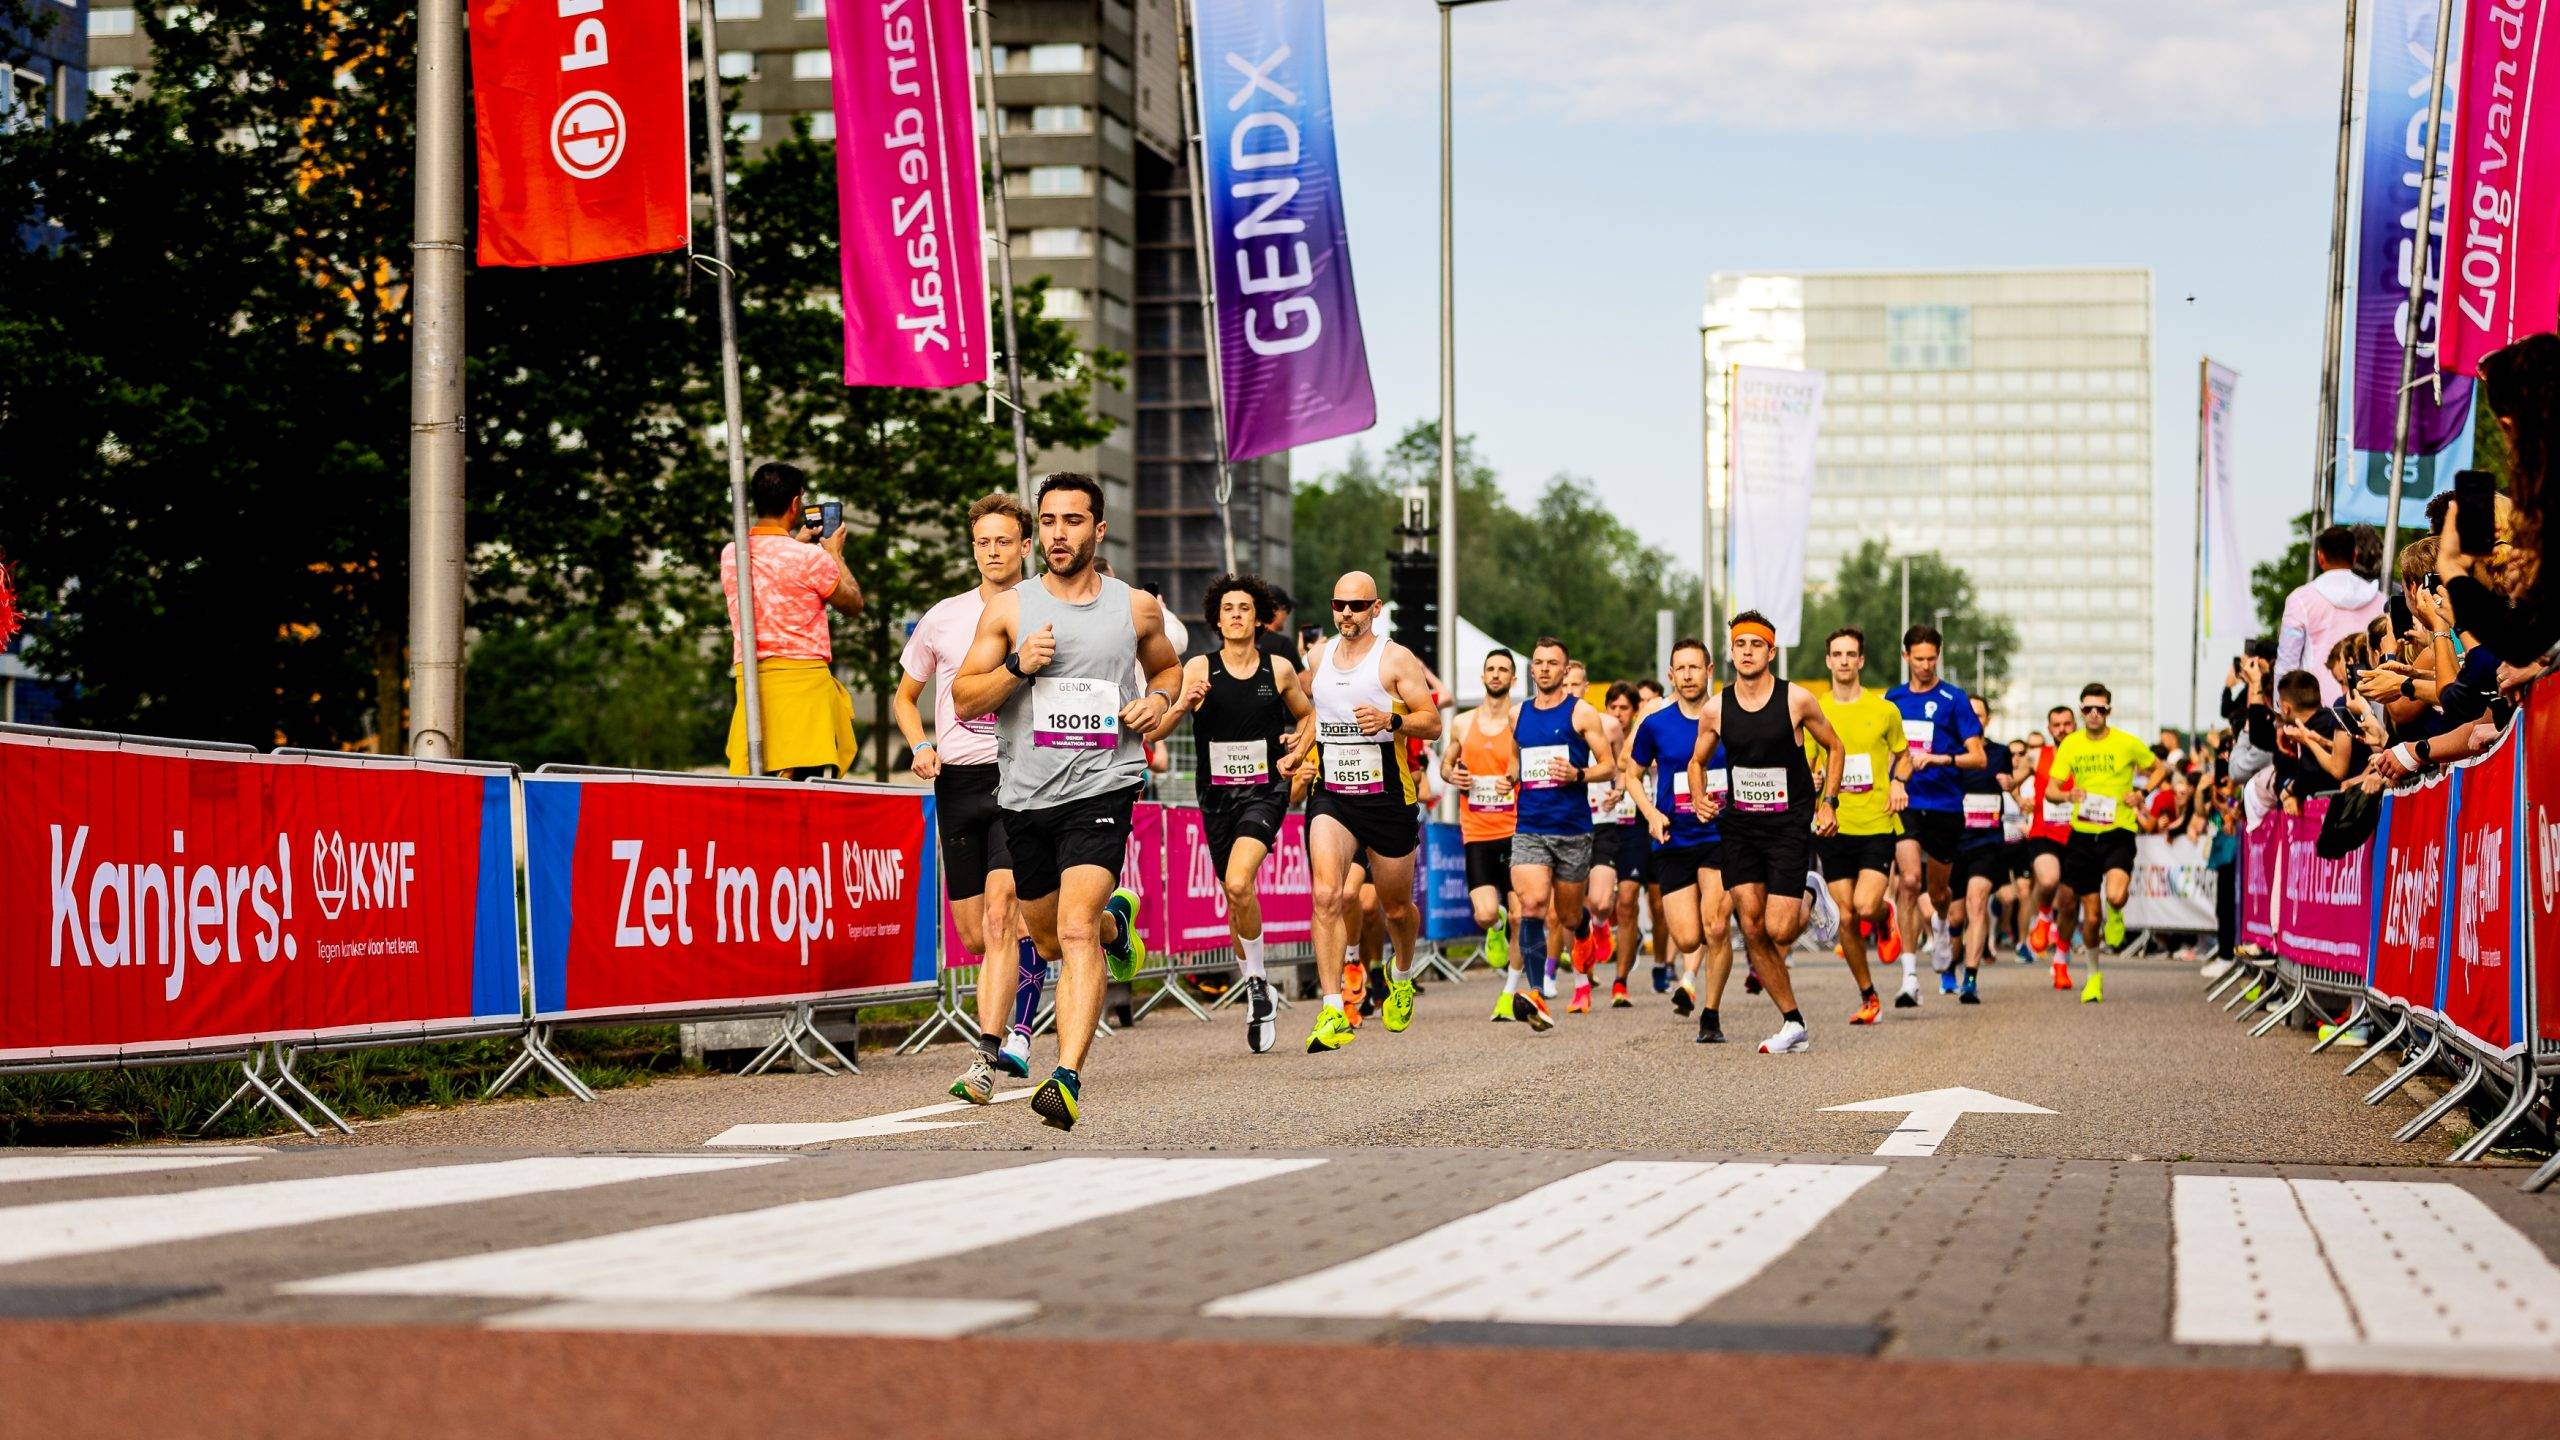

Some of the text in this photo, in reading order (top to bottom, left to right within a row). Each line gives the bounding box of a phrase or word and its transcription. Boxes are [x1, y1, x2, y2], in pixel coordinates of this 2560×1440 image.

[2479, 60, 2517, 175] van
[1225, 45, 1322, 357] GENDX
[2458, 180, 2515, 333] Zorg
[1059, 682, 1092, 692] GENDX
[1048, 713, 1101, 730] 18018
[1223, 764, 1255, 774] 16113
[1338, 759, 1361, 767] BART
[1528, 768, 1548, 778] 160
[1333, 770, 1370, 782] 16515
[1841, 774, 1863, 783] 013
[1742, 790, 1776, 801] 15091
[350, 841, 415, 910] KWF
[863, 849, 904, 901] KWF
[50, 824, 297, 1001] Kanjers!
[611, 840, 834, 966] Zet 'm op!
[316, 940, 340, 963] Tegen
[384, 938, 397, 954] het
